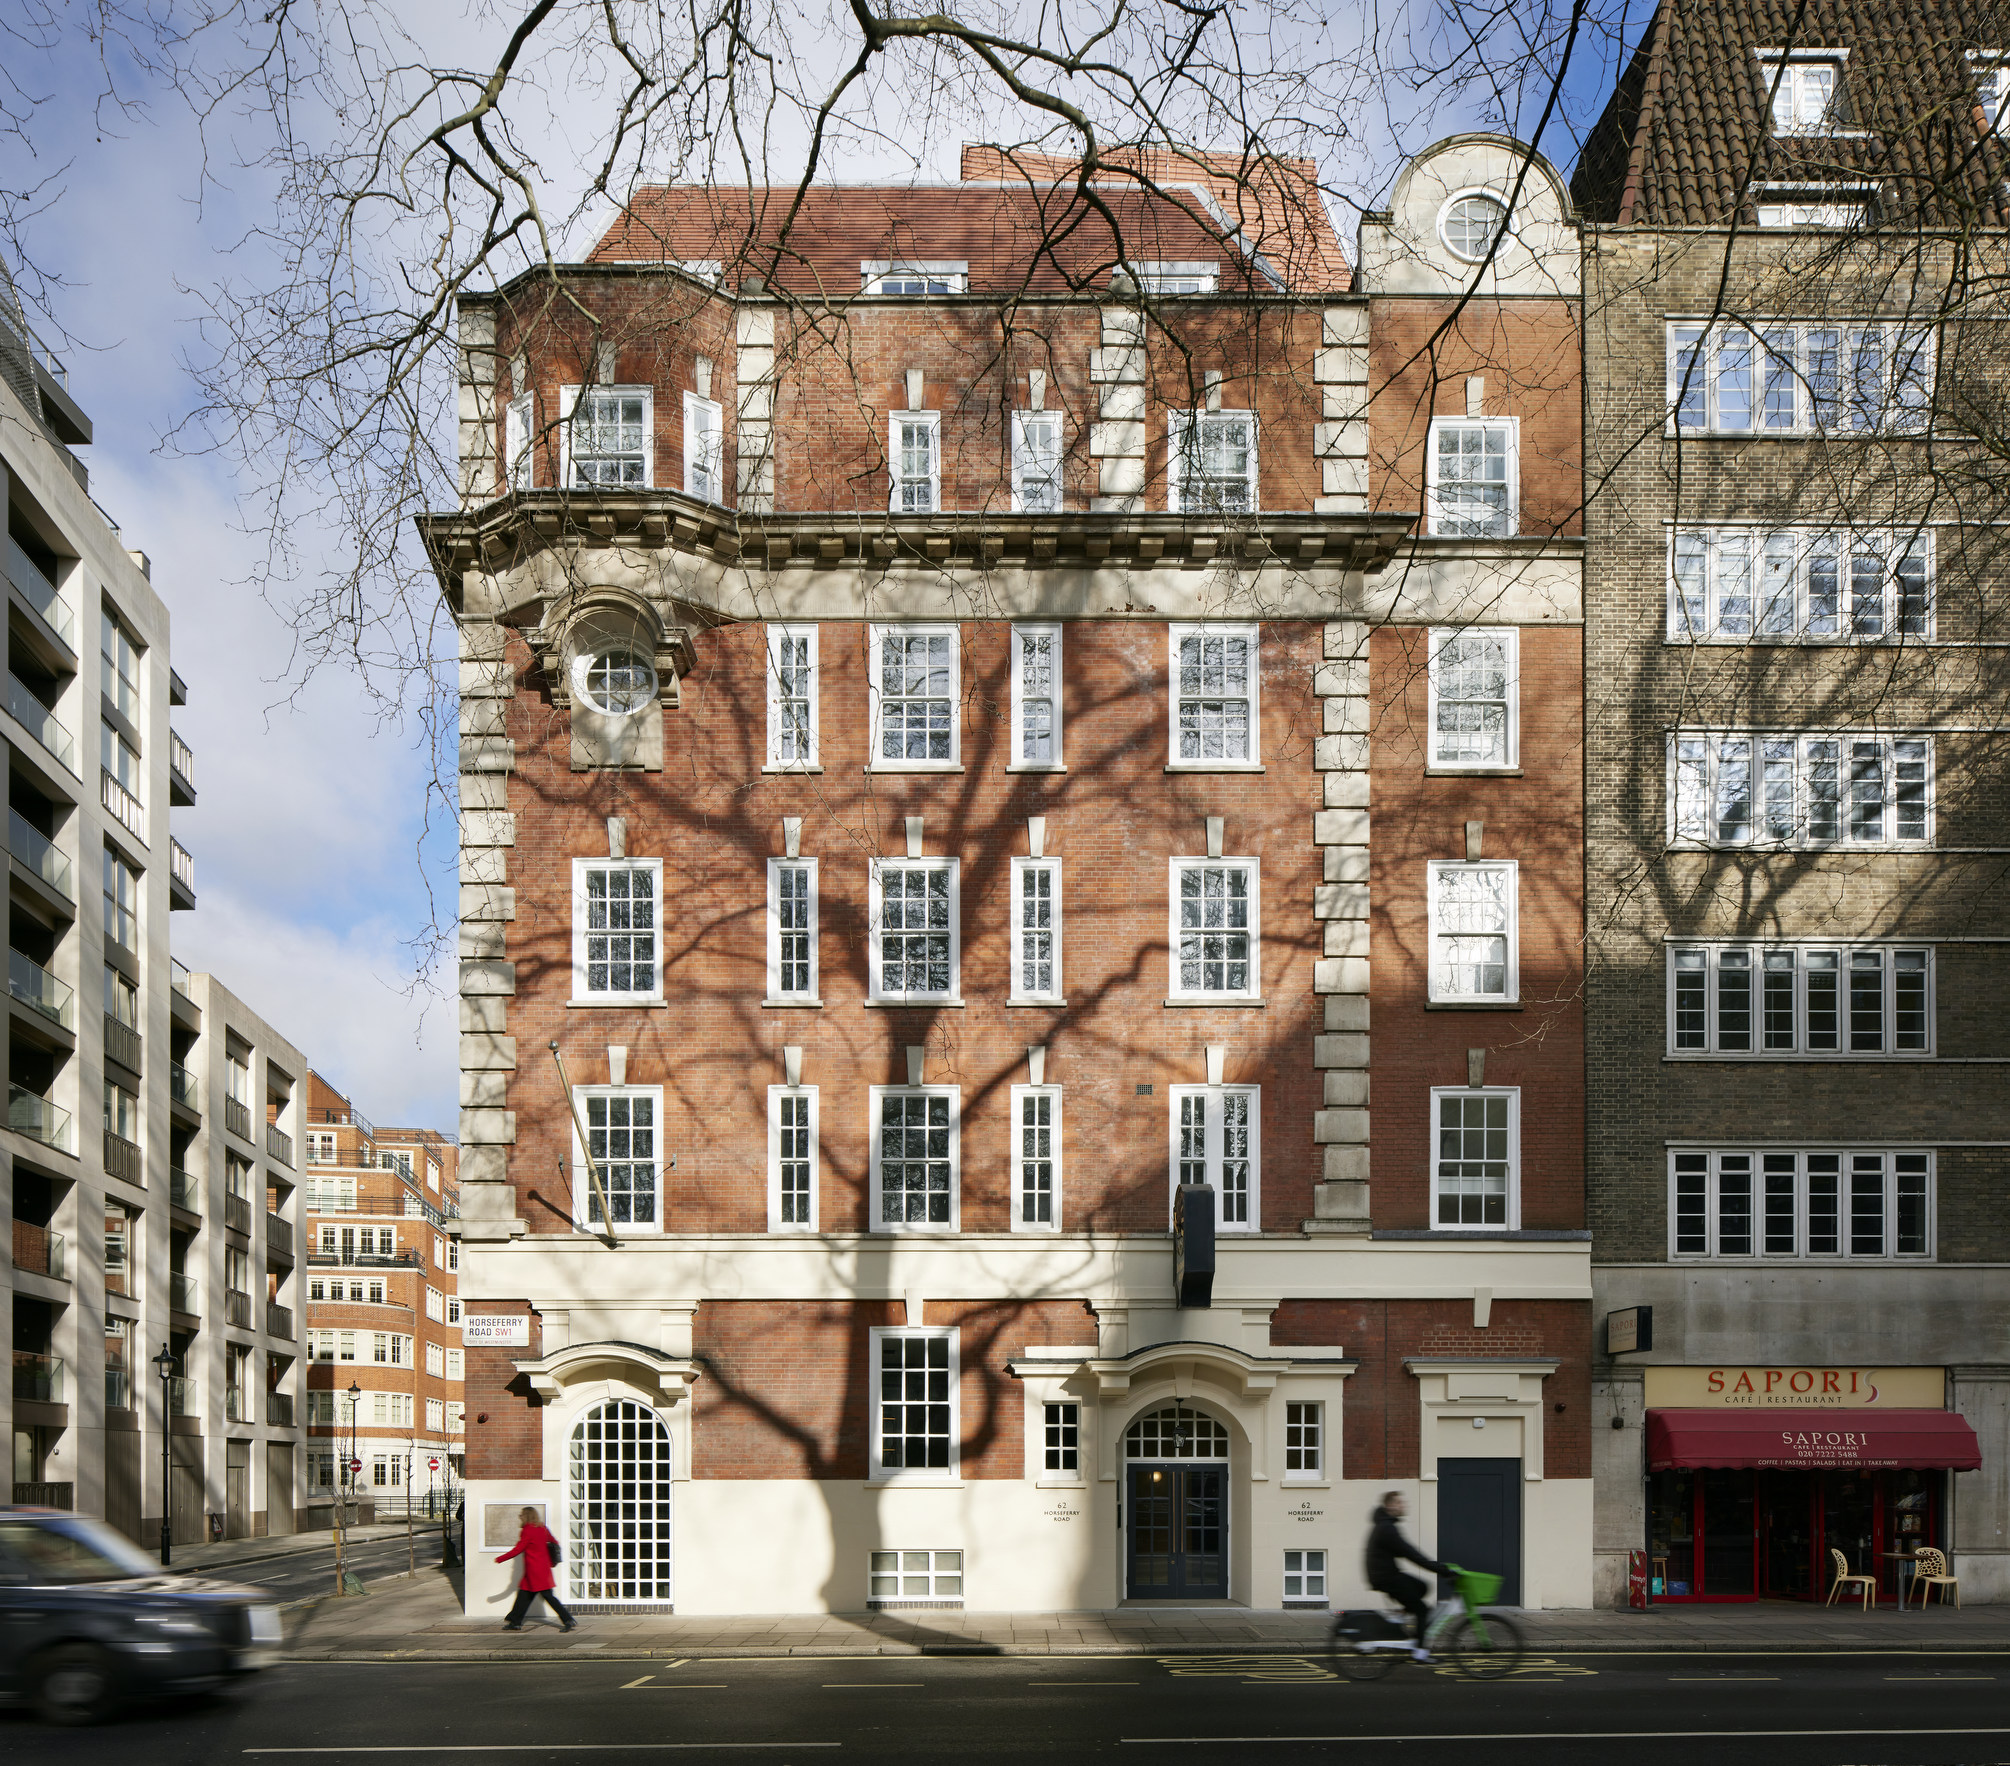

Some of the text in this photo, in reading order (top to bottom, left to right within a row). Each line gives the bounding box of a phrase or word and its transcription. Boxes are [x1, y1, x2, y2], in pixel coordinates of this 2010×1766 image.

[469, 1318, 523, 1326] HORSEFERRY
[1610, 1318, 1637, 1332] SAPORI
[469, 1328, 512, 1336] ROAD SW1
[1708, 1370, 1859, 1393] SAPORI
[1725, 1394, 1753, 1403] CAFÉ
[1782, 1432, 1868, 1445] SAPORI
[1156, 1657, 1338, 1680] STOP
